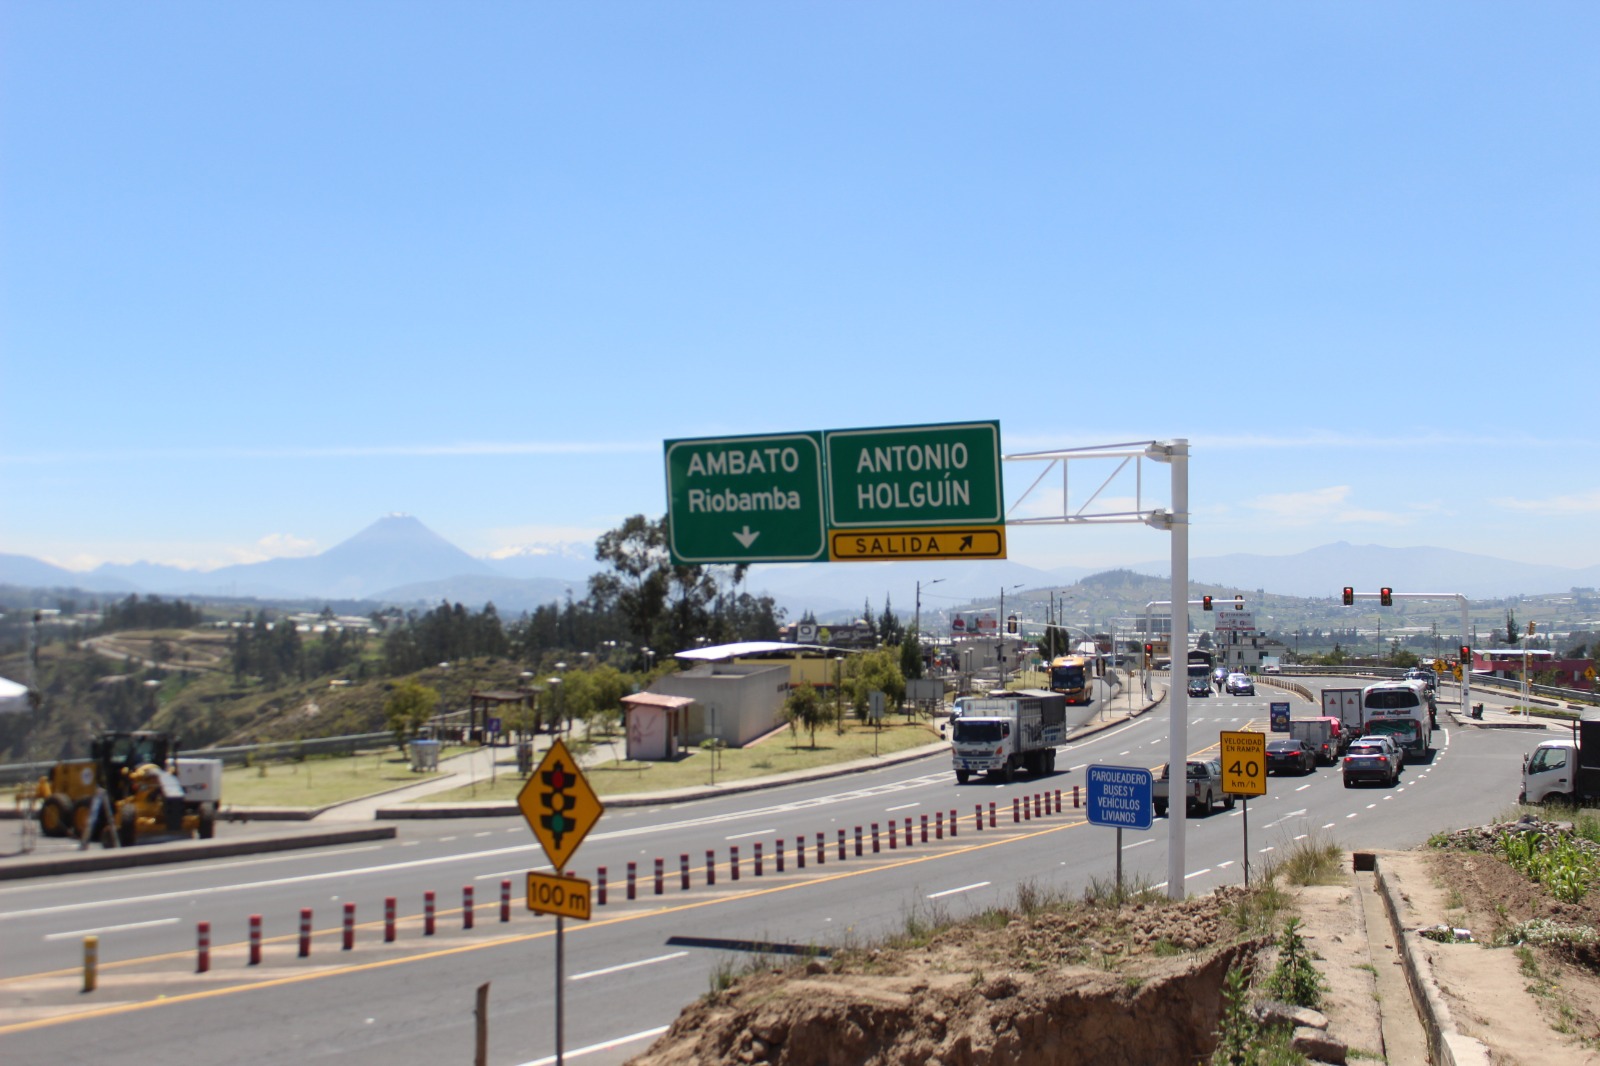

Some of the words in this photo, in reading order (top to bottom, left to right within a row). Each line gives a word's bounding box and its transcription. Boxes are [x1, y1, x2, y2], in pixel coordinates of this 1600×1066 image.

[686, 447, 799, 476] AMBATO
[857, 442, 968, 473] ANTONIO
[857, 472, 970, 509] HOLGUÍN
[688, 486, 800, 513] Riobamba
[856, 536, 940, 553] SALIDA
[1224, 737, 1262, 746] VELOCIDAD
[1236, 745, 1261, 753] RAMPA
[1228, 760, 1259, 778] 40
[1091, 770, 1147, 785] PARQUEADERO
[1231, 780, 1256, 788] km/h
[1103, 784, 1128, 797] BUSES
[1128, 785, 1135, 797] Y
[1097, 795, 1140, 810] VEHÍCULOS
[1101, 809, 1136, 823] LIVIANOS
[531, 882, 565, 907] 100
[569, 893, 586, 911] m
